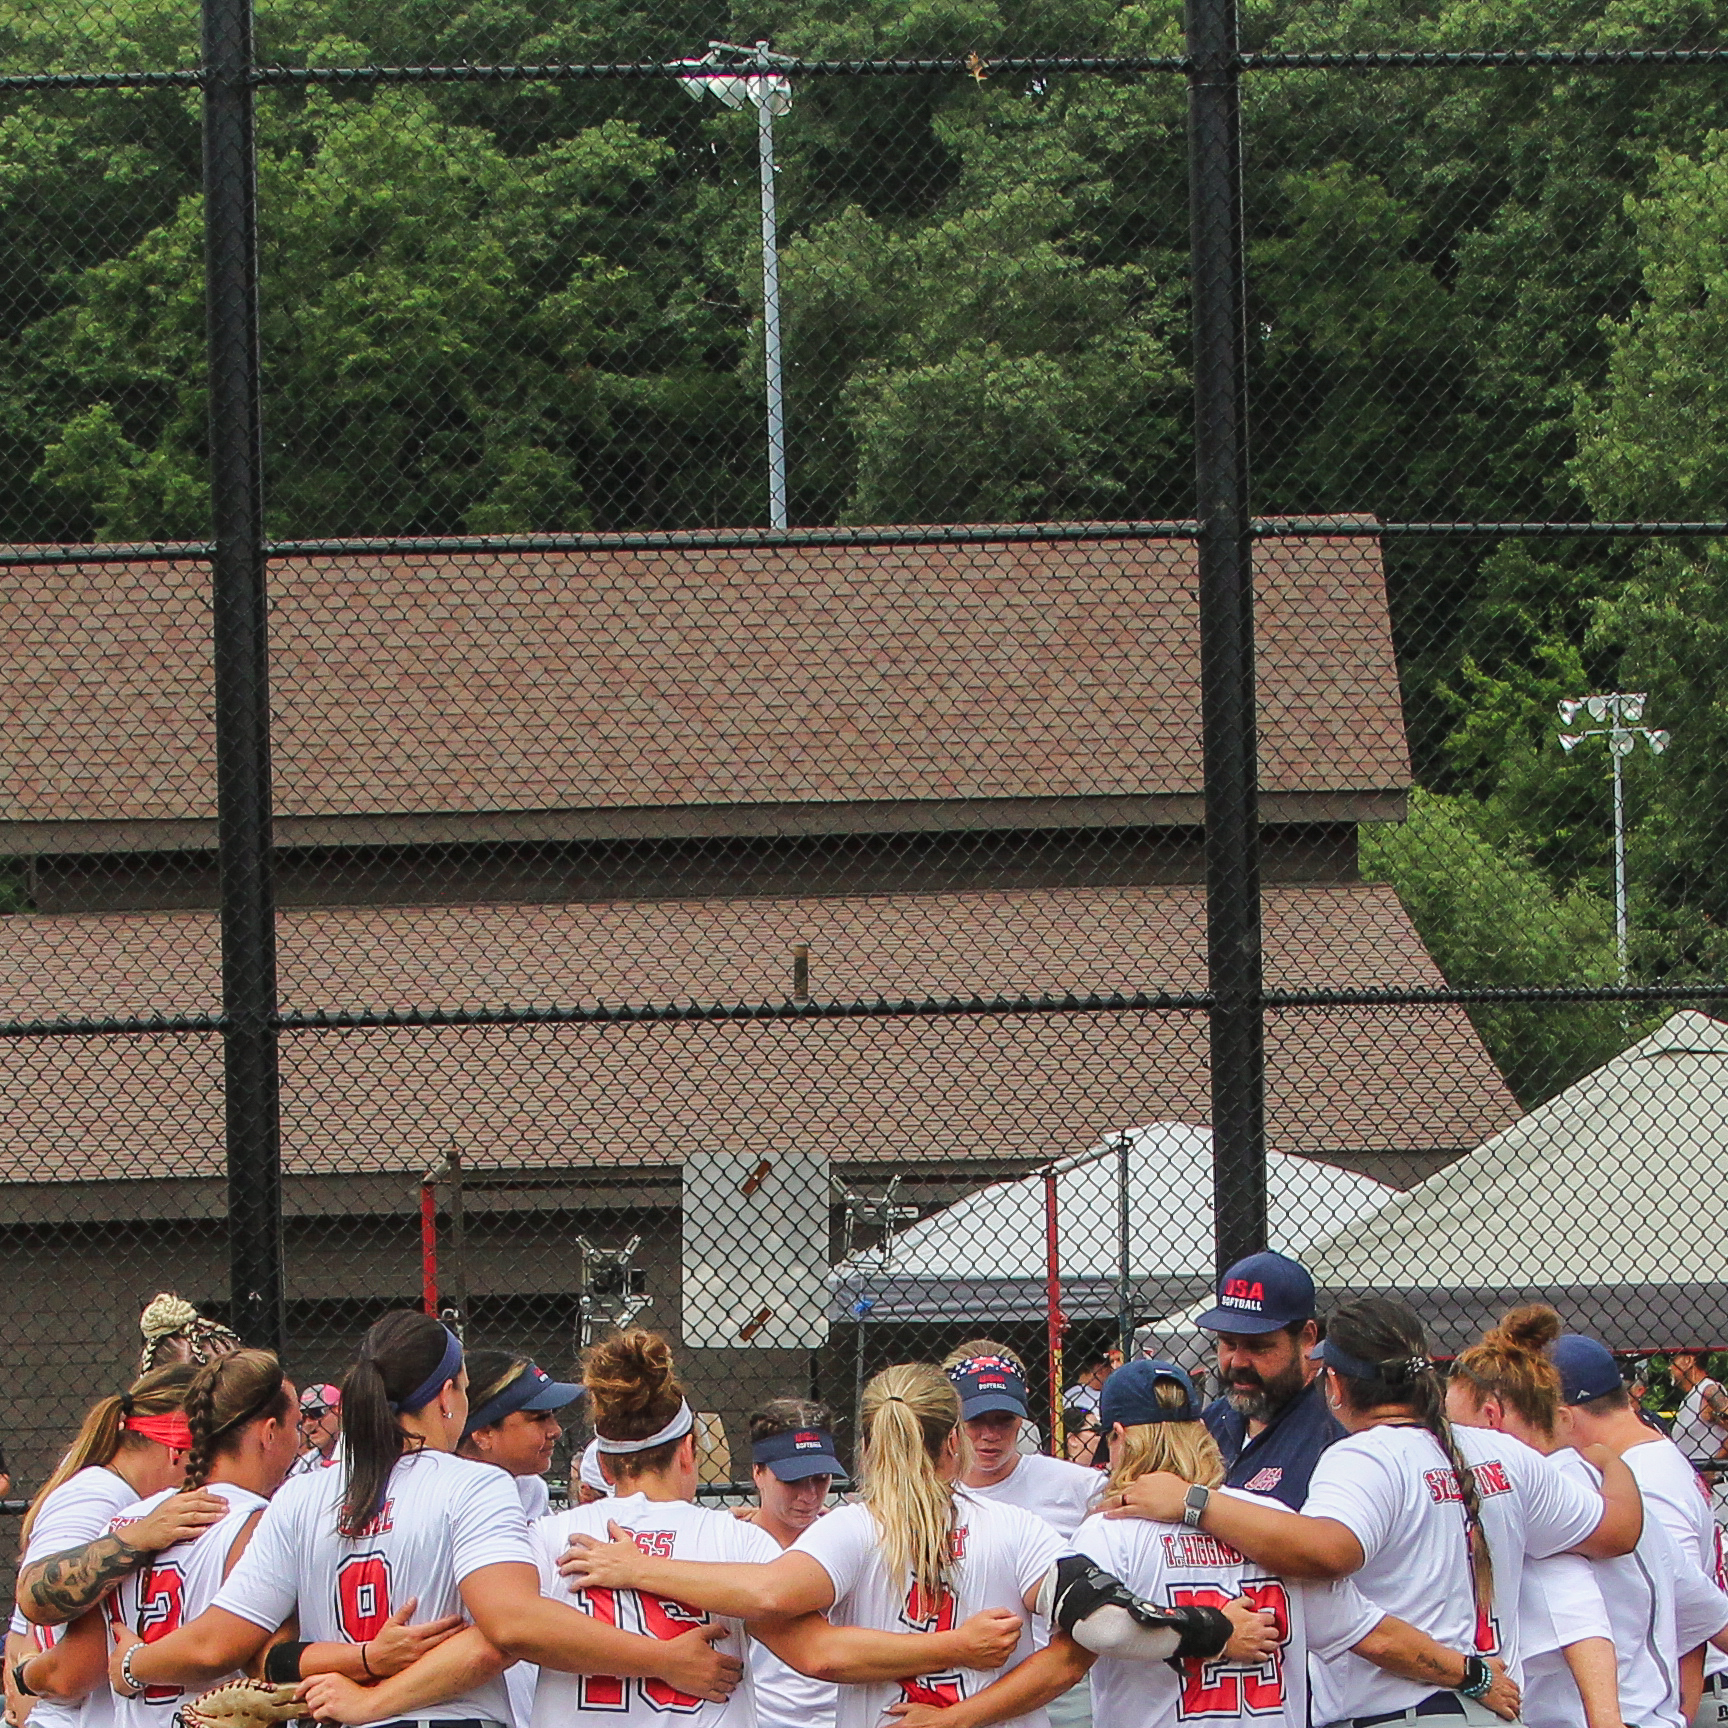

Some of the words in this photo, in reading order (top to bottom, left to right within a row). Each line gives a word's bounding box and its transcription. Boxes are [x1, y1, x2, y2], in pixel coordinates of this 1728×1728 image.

[1224, 1279, 1264, 1301] USA
[1222, 1295, 1262, 1312] SOFTBALL
[1166, 1577, 1293, 1722] 23
